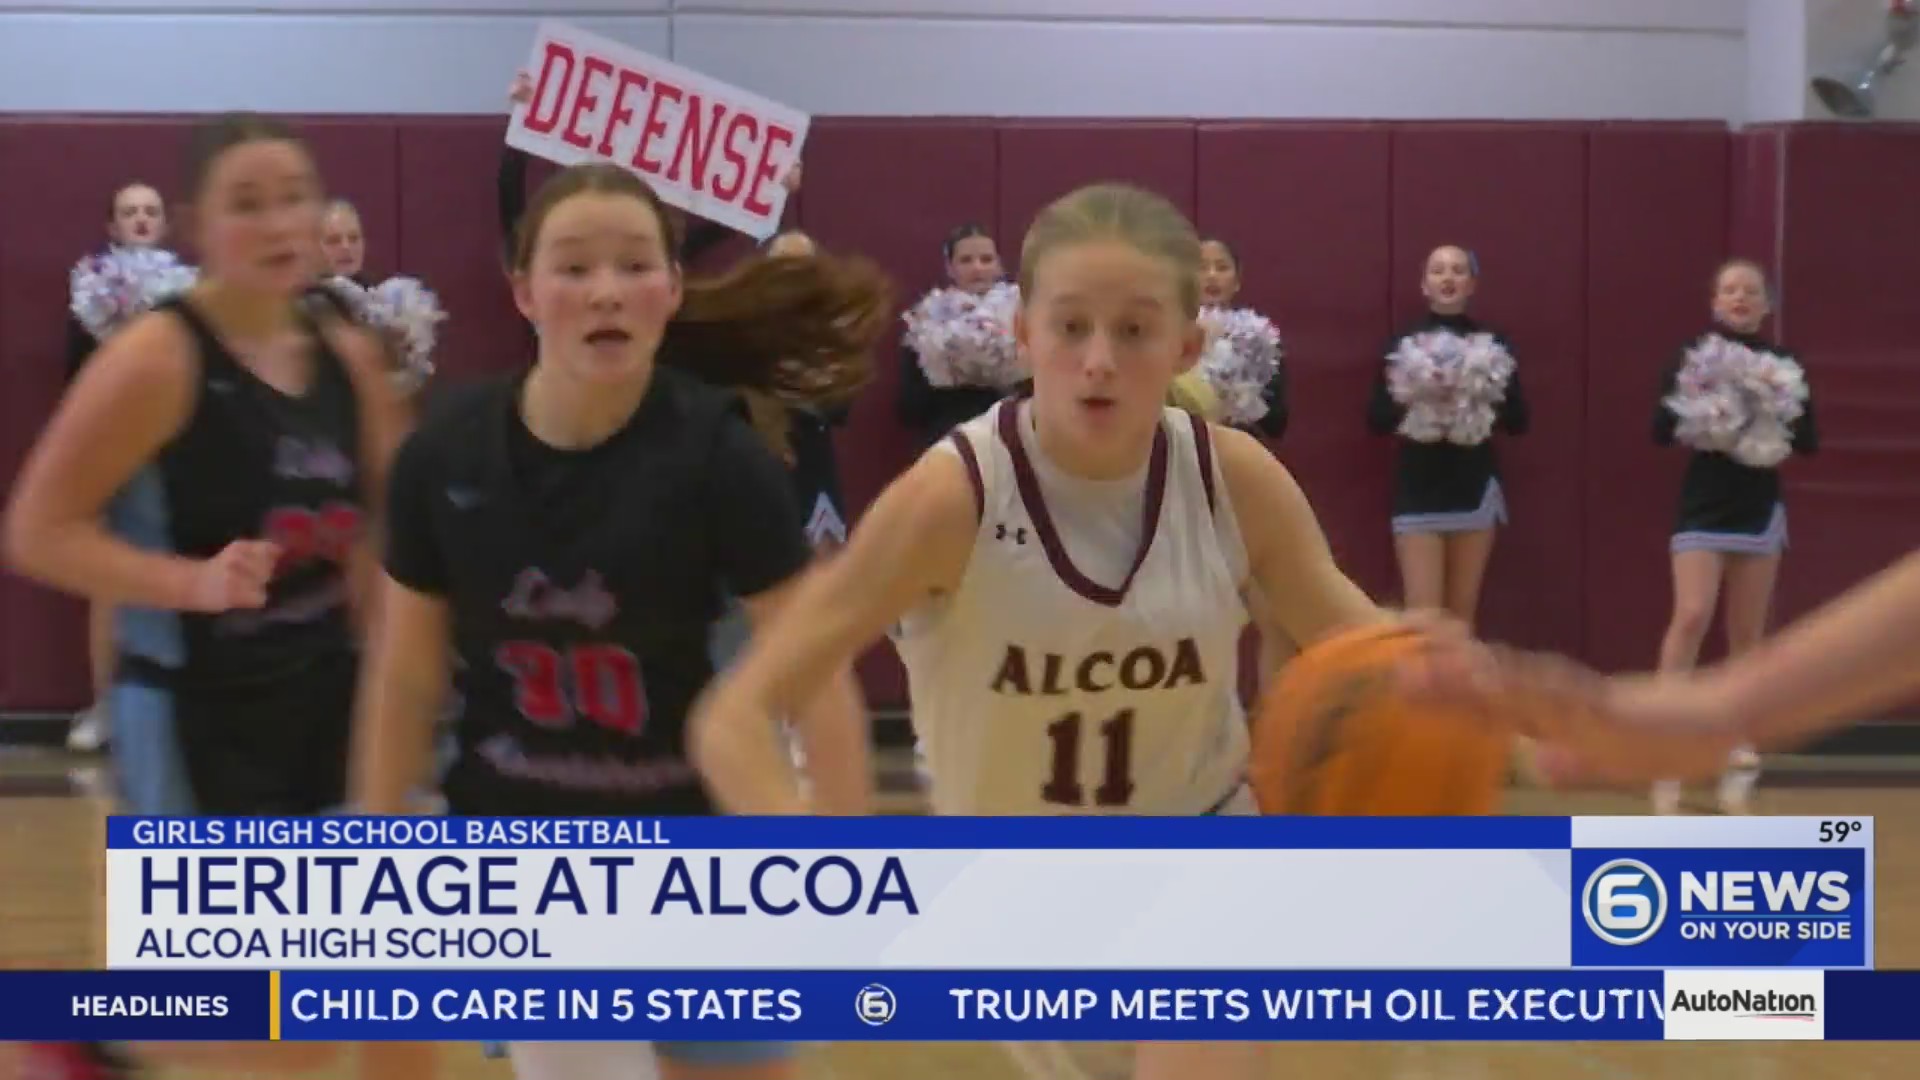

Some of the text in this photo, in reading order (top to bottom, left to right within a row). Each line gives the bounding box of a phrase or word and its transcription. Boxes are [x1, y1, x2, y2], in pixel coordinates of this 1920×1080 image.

[524, 41, 794, 217] DEFENSE
[990, 637, 1207, 696] ALCOA
[1041, 707, 1136, 806] 11
